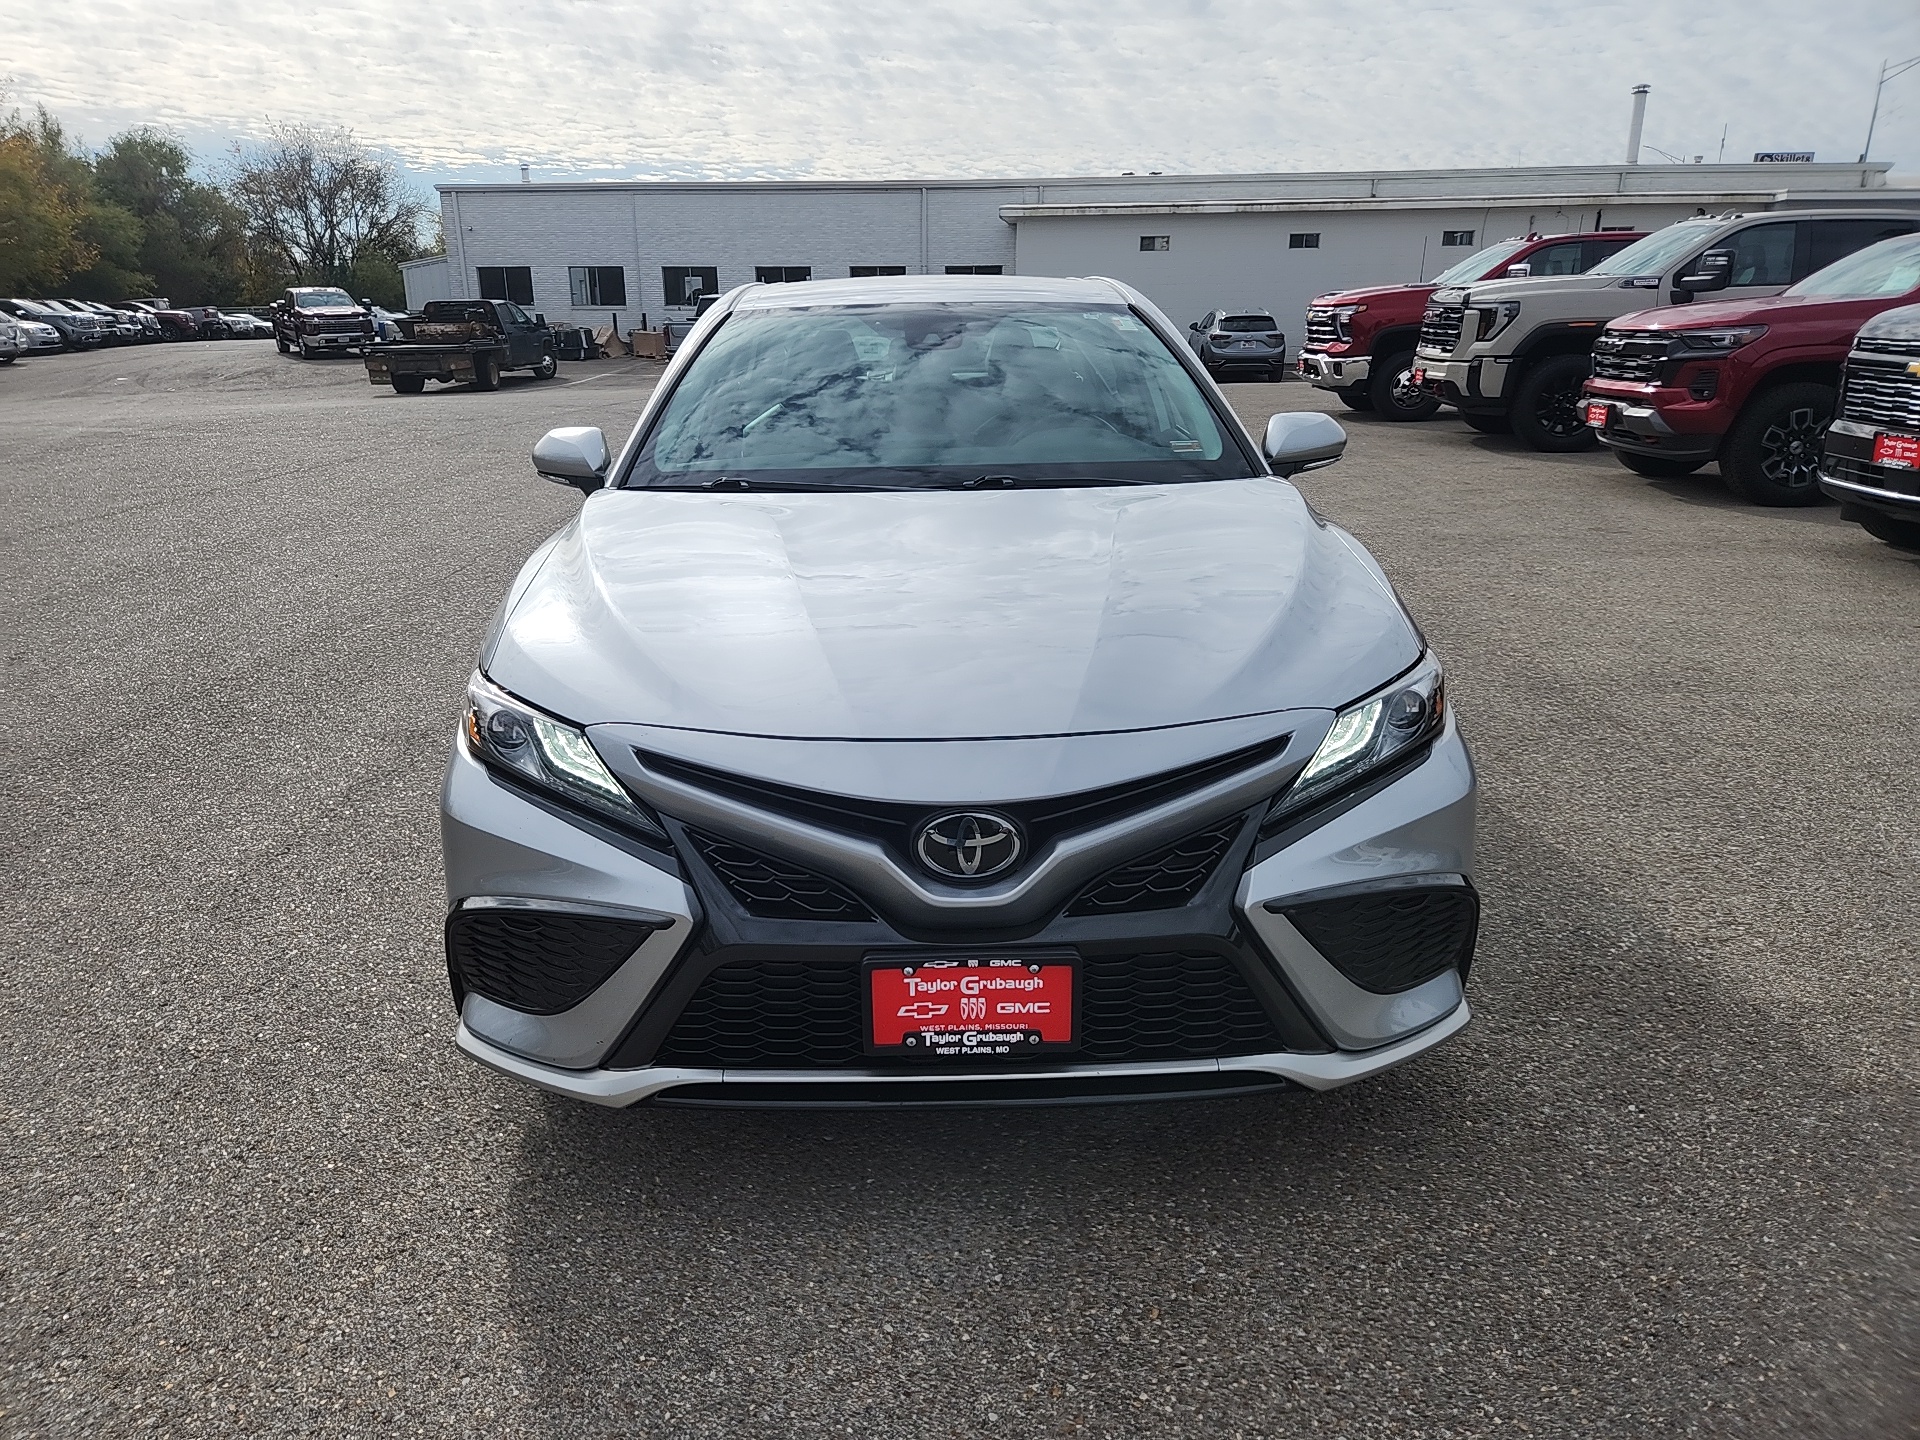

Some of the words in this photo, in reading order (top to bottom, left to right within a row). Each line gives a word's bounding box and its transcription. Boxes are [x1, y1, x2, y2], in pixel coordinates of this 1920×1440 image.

[904, 978, 957, 996] Taylor
[960, 976, 1043, 994] Grubaugh
[996, 1002, 1051, 1014] GMC
[947, 1024, 983, 1032] PLAINS,
[984, 1023, 1029, 1031] MISSOURI
[922, 1032, 961, 1046] Taylor
[962, 1031, 1025, 1046] Grubaugh
[936, 1047, 960, 1055] WEST
[961, 1047, 995, 1055] PLAINS,
[995, 1045, 1010, 1054] MO
